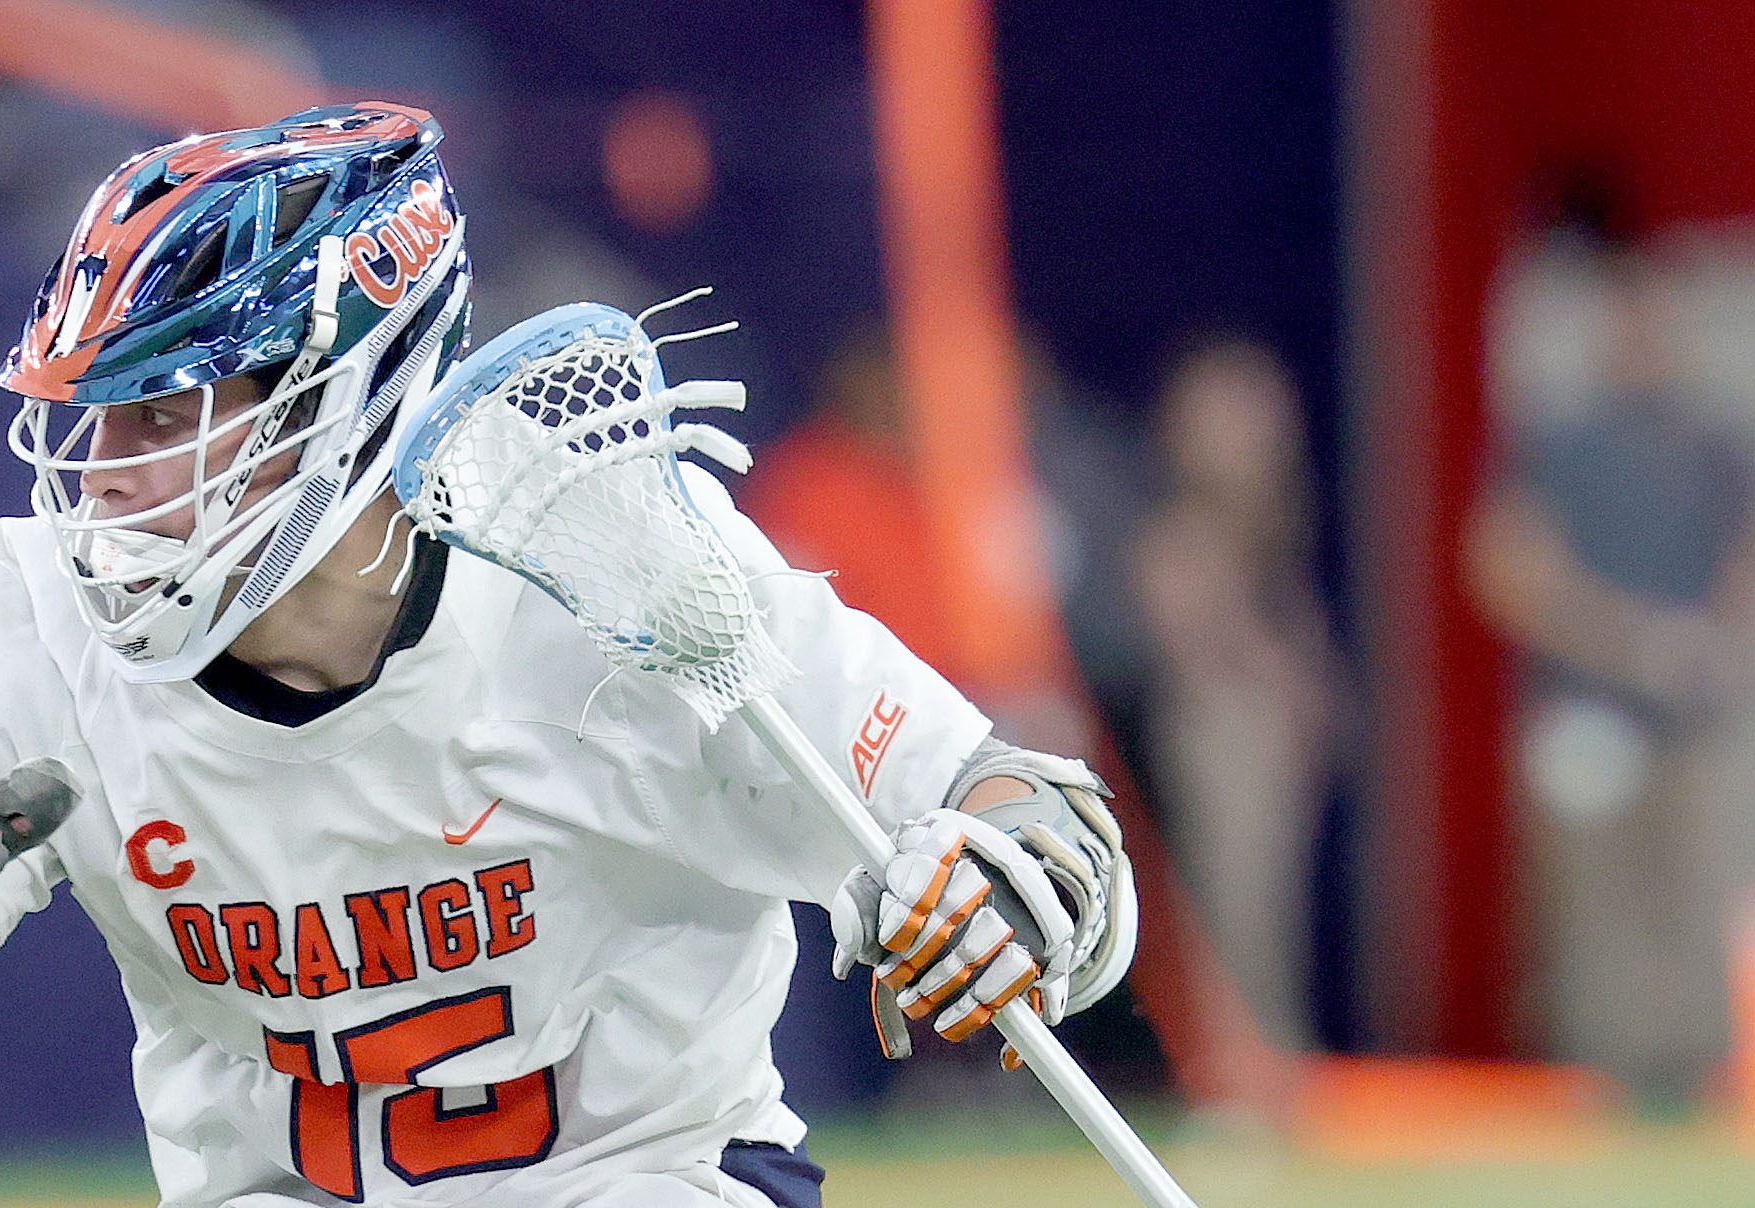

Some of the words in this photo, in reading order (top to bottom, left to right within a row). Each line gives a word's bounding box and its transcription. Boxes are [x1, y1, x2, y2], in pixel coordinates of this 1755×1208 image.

[852, 690, 904, 796] ACC
[126, 820, 195, 890] C
[166, 858, 536, 999] ORANGE
[263, 985, 560, 1204] 15
